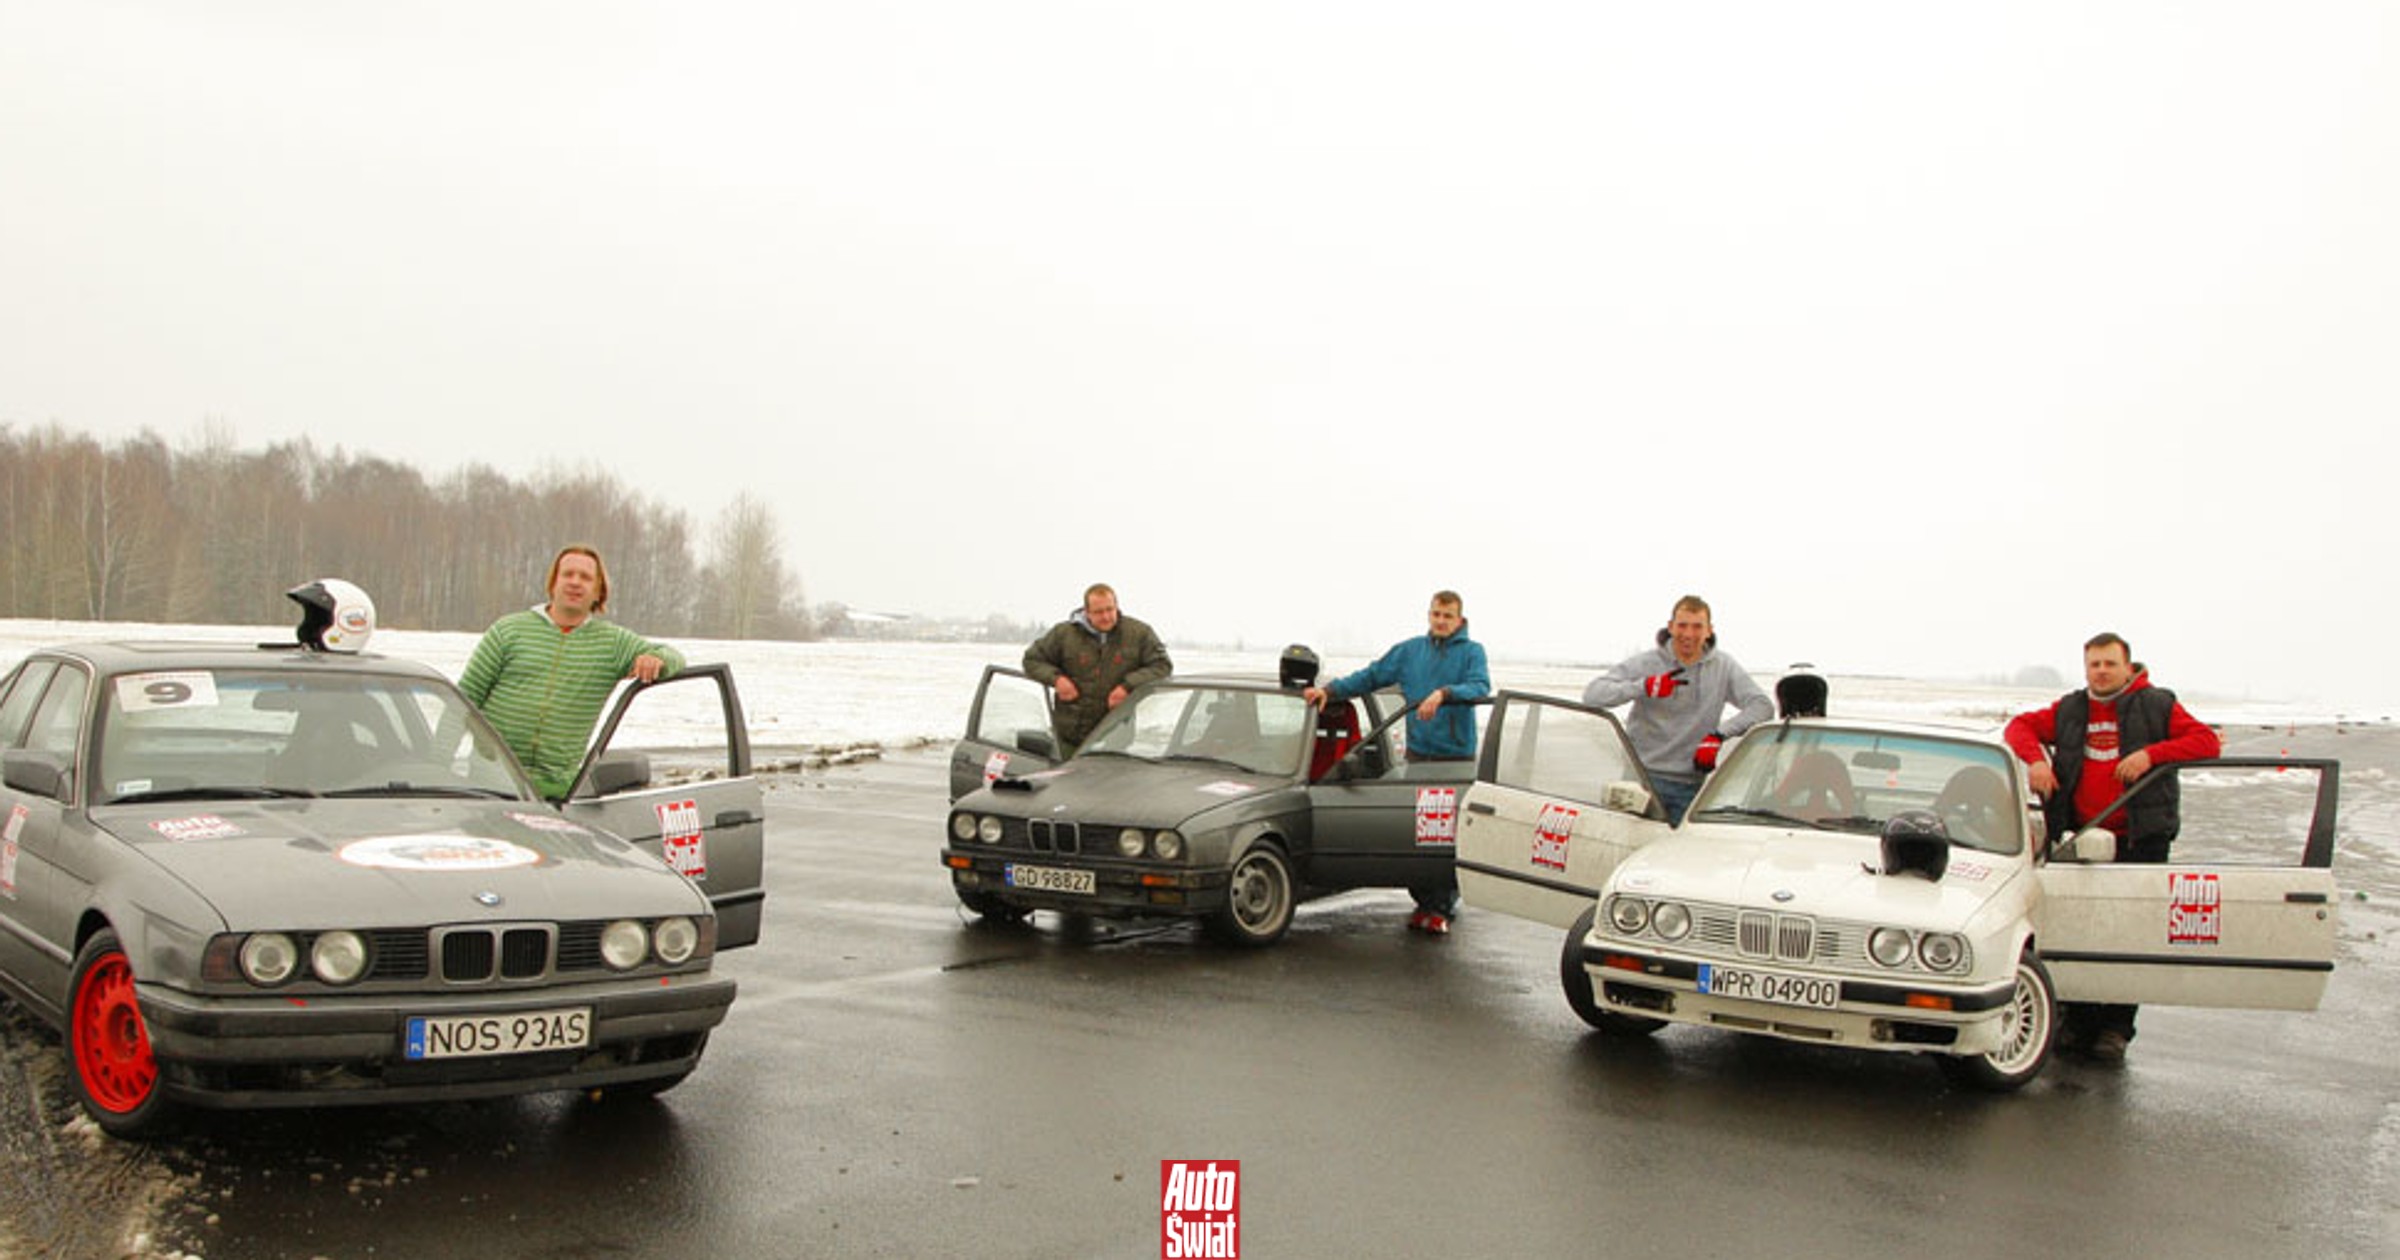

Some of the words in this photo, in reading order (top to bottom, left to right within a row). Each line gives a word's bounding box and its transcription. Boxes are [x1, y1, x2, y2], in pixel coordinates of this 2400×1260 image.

[144, 682, 191, 704] 9
[1417, 787, 1453, 814] Auto
[660, 801, 701, 836] Auto
[1015, 866, 1038, 886] GD
[1042, 869, 1092, 891] 98827
[2171, 874, 2219, 905] Auto
[1712, 969, 1755, 997] WPR
[1762, 976, 1836, 1007] 04900
[430, 1021, 500, 1053] NOS
[512, 1013, 585, 1049] 93AS
